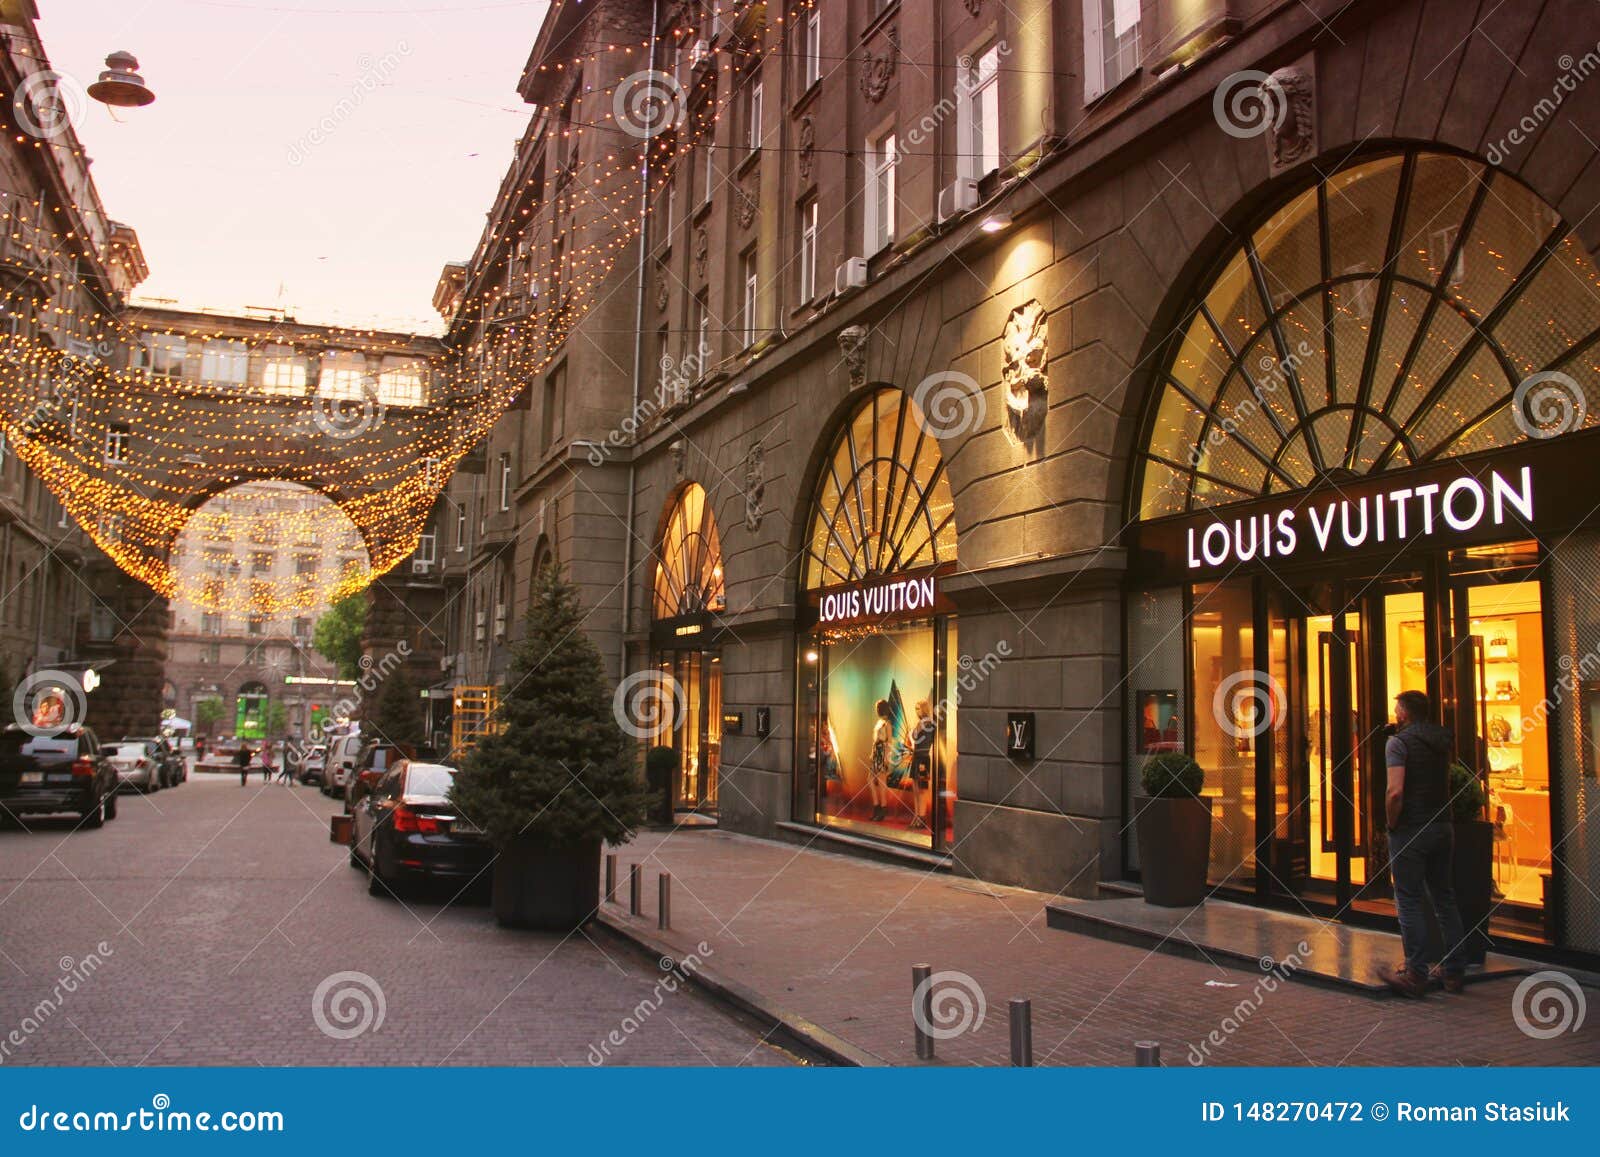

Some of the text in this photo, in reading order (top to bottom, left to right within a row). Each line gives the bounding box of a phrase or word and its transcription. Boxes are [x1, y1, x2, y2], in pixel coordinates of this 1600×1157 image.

[1187, 466, 1534, 569] LOUIS VUITTON
[820, 576, 935, 622] LOUIS VUITTON
